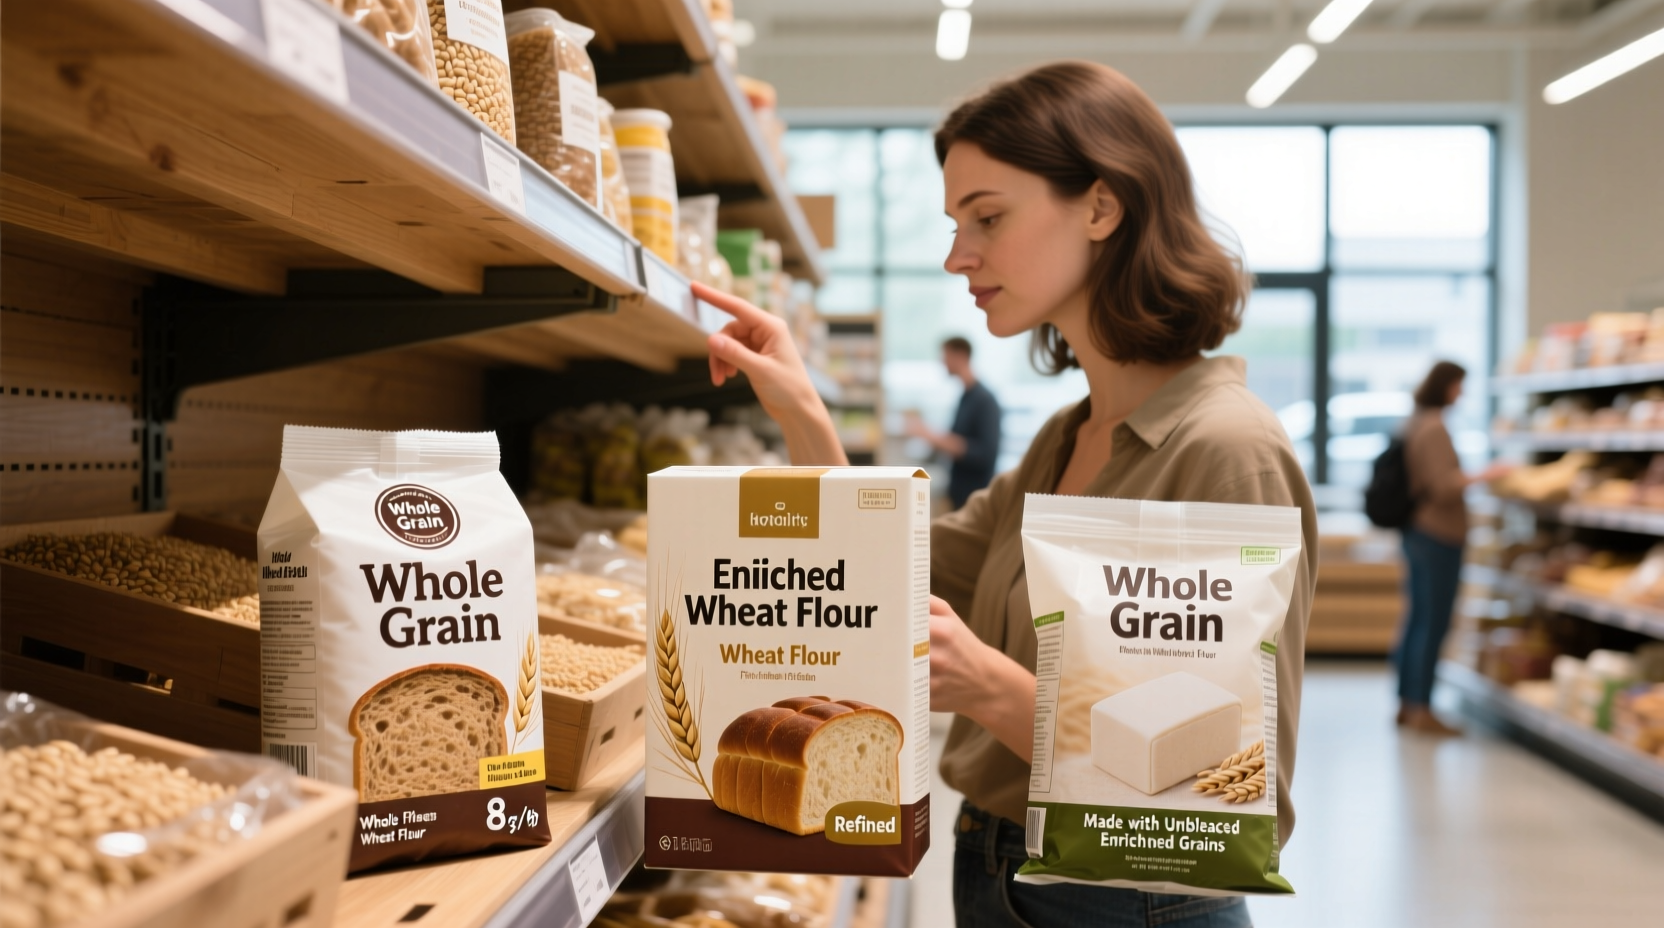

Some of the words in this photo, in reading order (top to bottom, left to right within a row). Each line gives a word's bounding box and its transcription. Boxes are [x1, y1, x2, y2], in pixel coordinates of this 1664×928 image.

[387, 500, 441, 516] Whole
[359, 559, 504, 603] Whole
[713, 557, 846, 591] Eniiched
[1102, 564, 1233, 601] Whole
[379, 602, 502, 649] Grain
[684, 593, 788, 626] Wheat
[796, 595, 879, 629] Flour
[1109, 602, 1224, 643] Grain
[719, 642, 784, 666] Wheat
[789, 643, 842, 667] Flour
[834, 813, 896, 834] Refined
[1083, 812, 1124, 830] Made
[1127, 813, 1160, 831] with
[1164, 815, 1241, 835] Unbleaced
[1178, 834, 1226, 853] Grains
